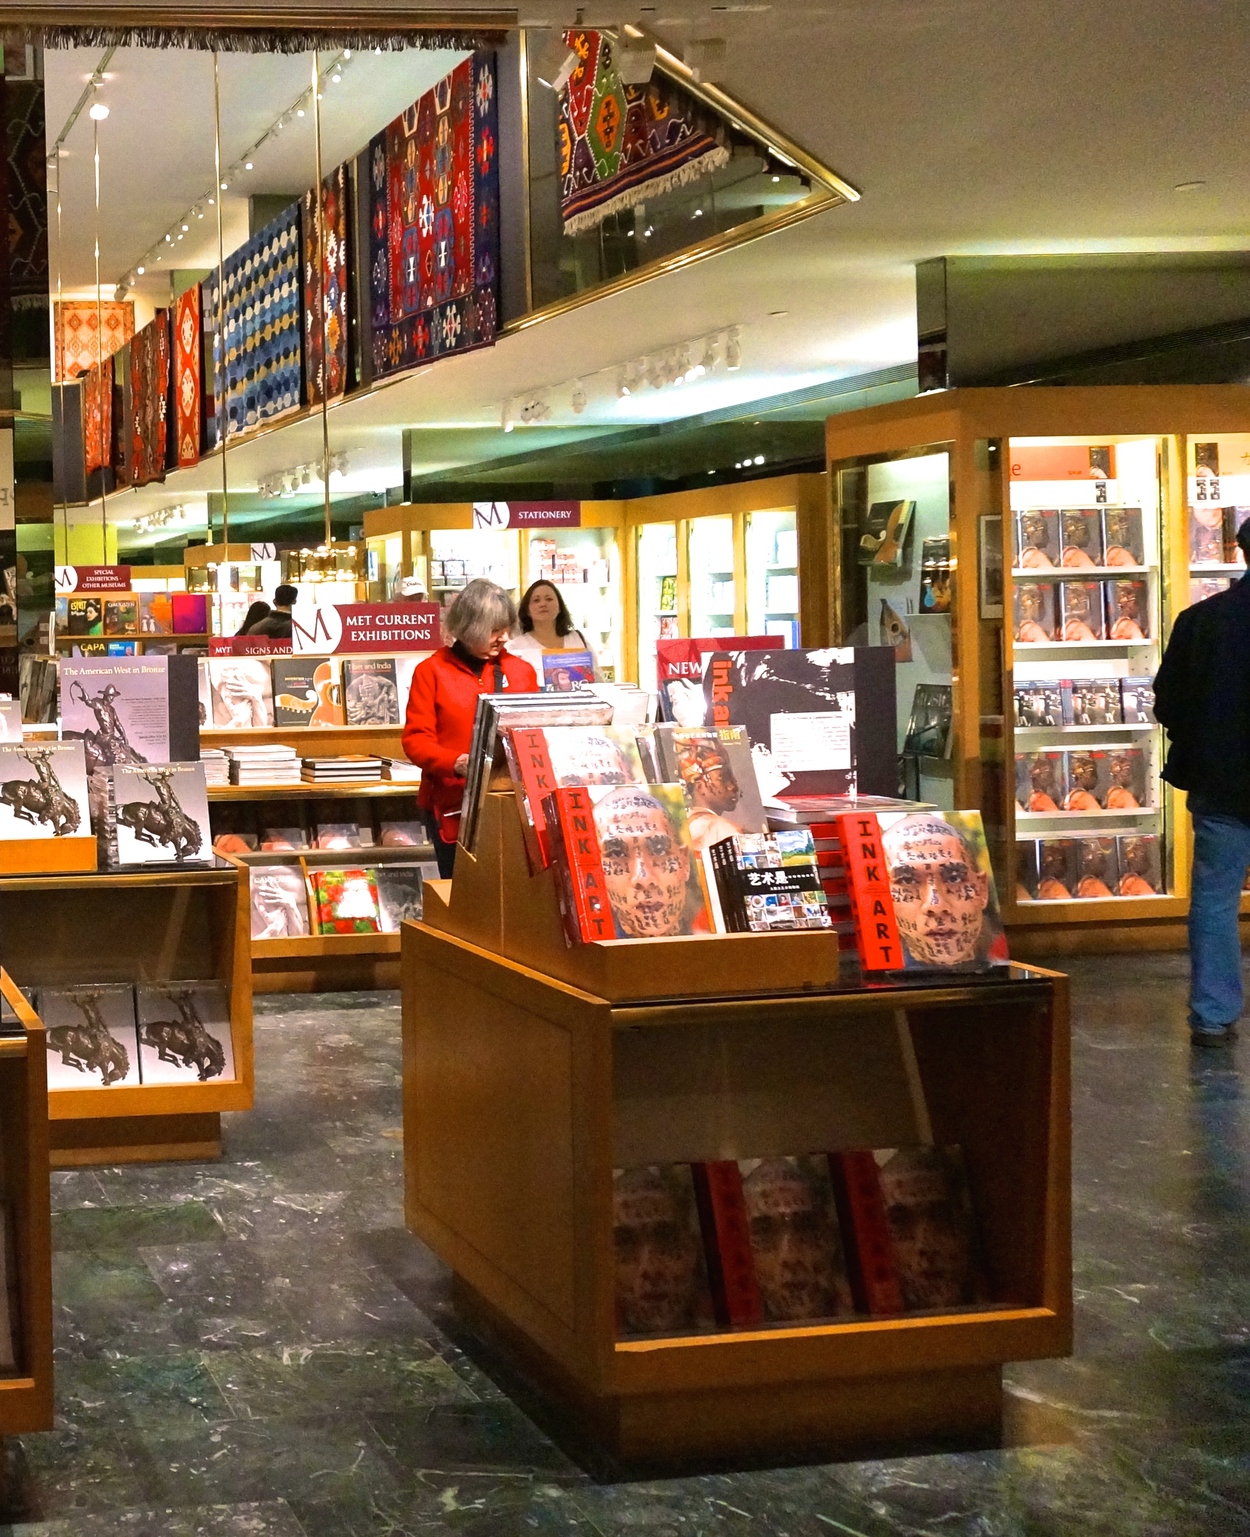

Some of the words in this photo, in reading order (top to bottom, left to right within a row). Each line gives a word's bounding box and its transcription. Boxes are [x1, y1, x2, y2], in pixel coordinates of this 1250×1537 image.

[518, 510, 572, 520] STATIONERY
[346, 615, 372, 626] MET
[376, 613, 435, 626] CURRENT
[351, 629, 431, 642] EXHIBITIONS
[80, 643, 105, 651] CAPA
[245, 646, 271, 655] SIGNS
[273, 646, 293, 654] AND
[63, 667, 79, 676] The
[79, 667, 113, 675] American
[113, 666, 131, 674] West
[132, 666, 140, 674] in
[141, 665, 165, 674] Bronze
[668, 662, 701, 675] NEW
[568, 793, 592, 855] INK
[857, 821, 881, 882] INK
[873, 900, 893, 963] ART
